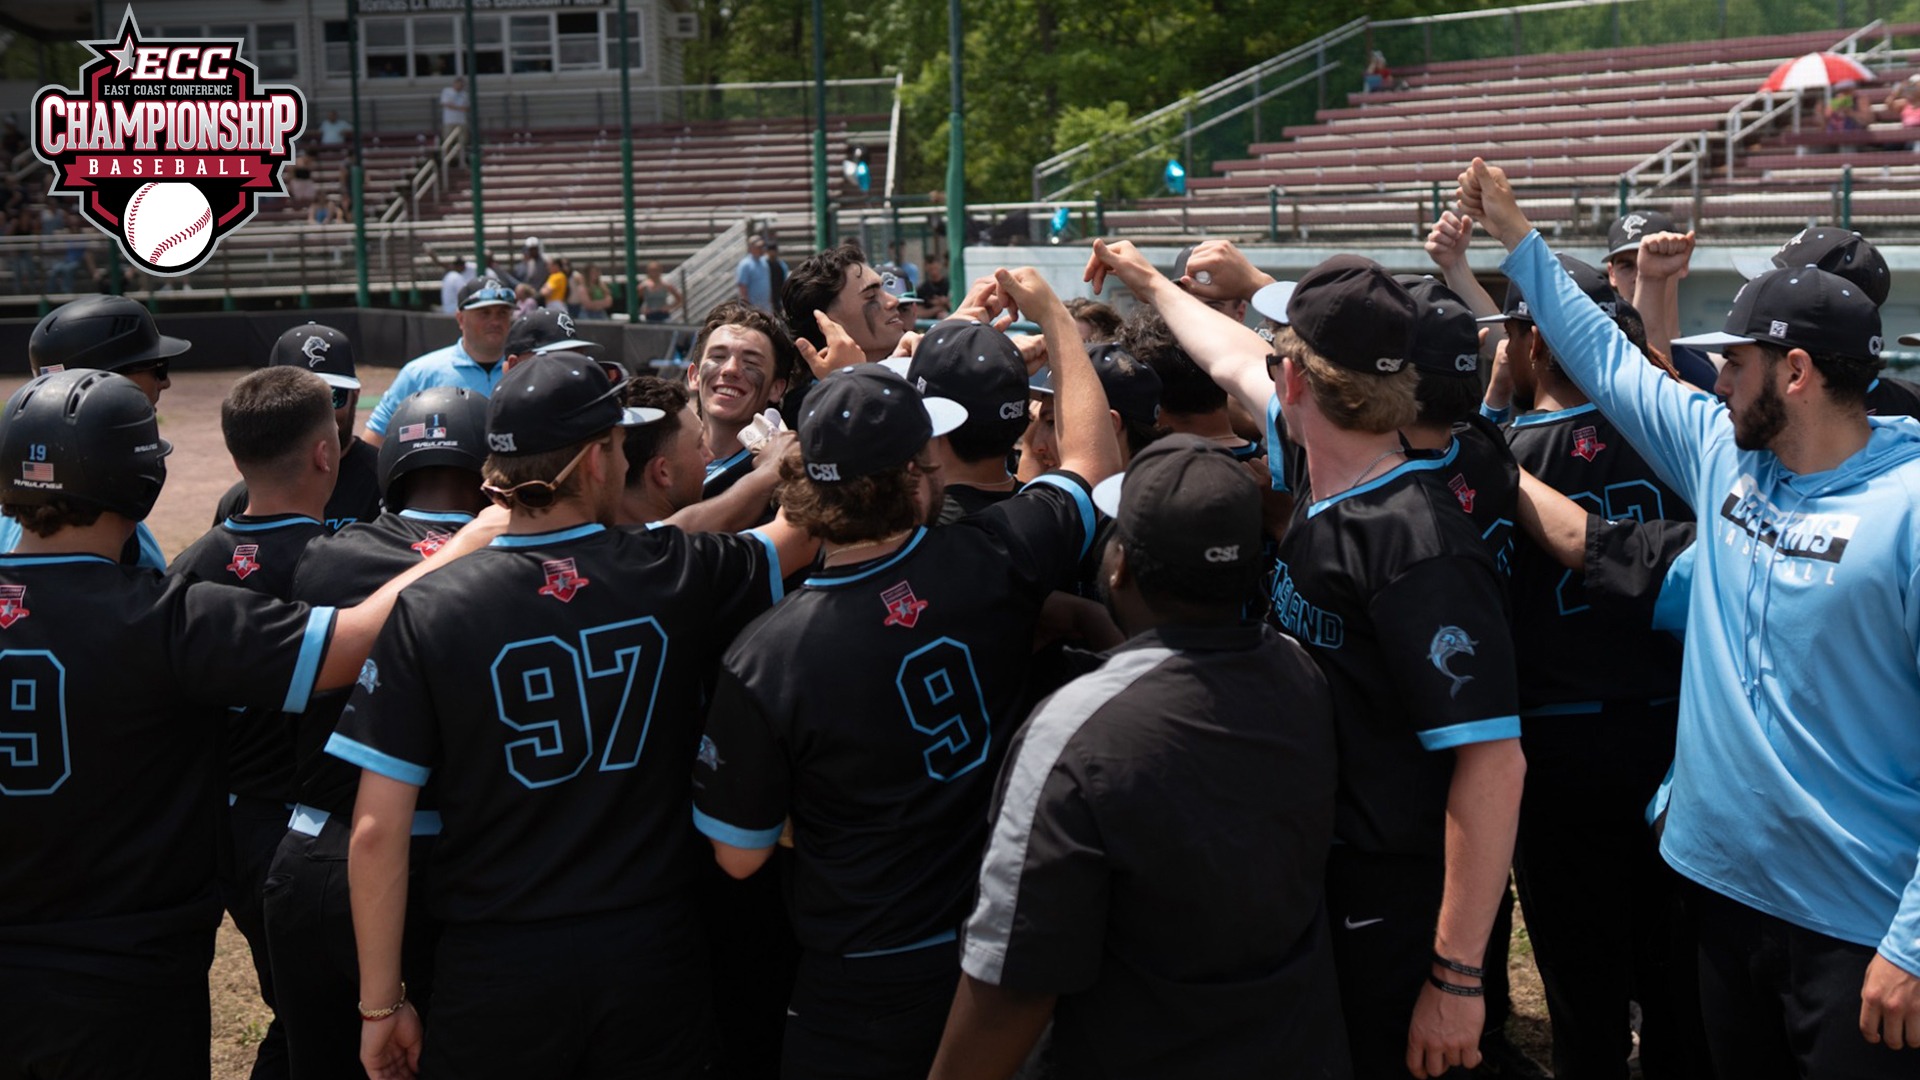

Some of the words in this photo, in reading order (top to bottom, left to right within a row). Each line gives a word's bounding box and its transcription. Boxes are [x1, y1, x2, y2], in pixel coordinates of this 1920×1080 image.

[999, 400, 1025, 420] CSI
[432, 413, 440, 427] 1
[487, 433, 517, 452] CSI
[29, 443, 47, 461] 19
[807, 463, 841, 481] CSI
[1204, 545, 1240, 563] CSI
[490, 615, 669, 789] 97
[895, 635, 991, 781] 9
